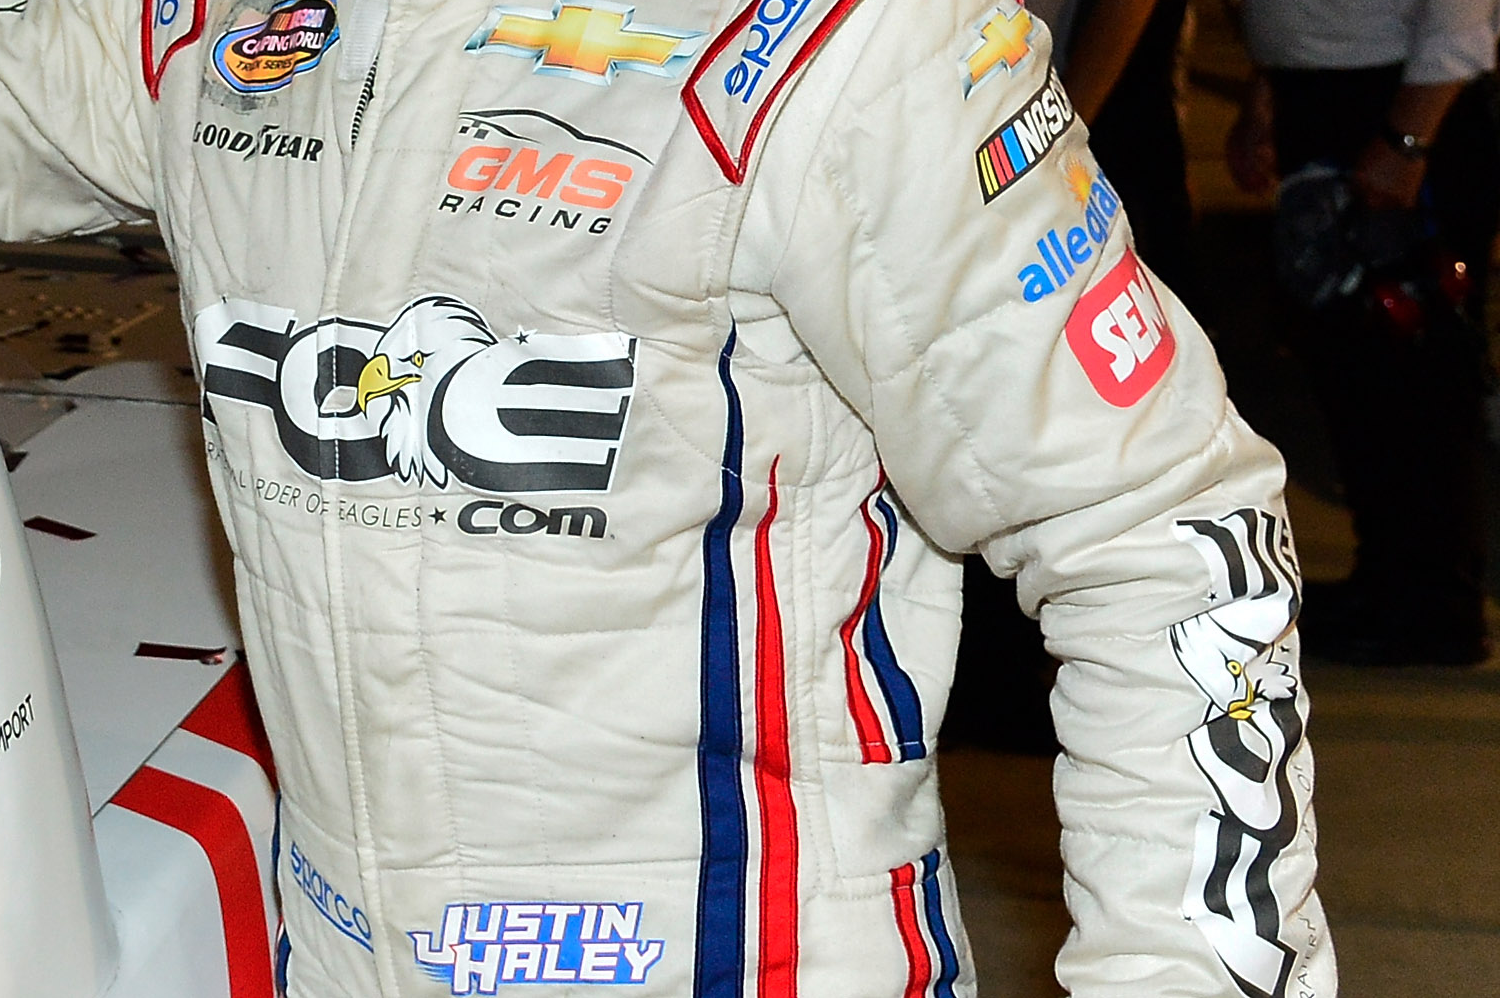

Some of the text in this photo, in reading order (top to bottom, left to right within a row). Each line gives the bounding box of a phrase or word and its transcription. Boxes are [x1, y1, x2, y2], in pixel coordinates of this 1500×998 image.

[446, 145, 635, 210] GMS
[438, 192, 612, 236] RACING
[194, 299, 640, 495] FOE
[255, 478, 302, 508] RDER
[305, 493, 331, 516] OF
[338, 500, 423, 529] EAGLES
[290, 840, 374, 946] sparco
[412, 901, 643, 966] JUSTIN
[451, 939, 666, 996] HALEY
